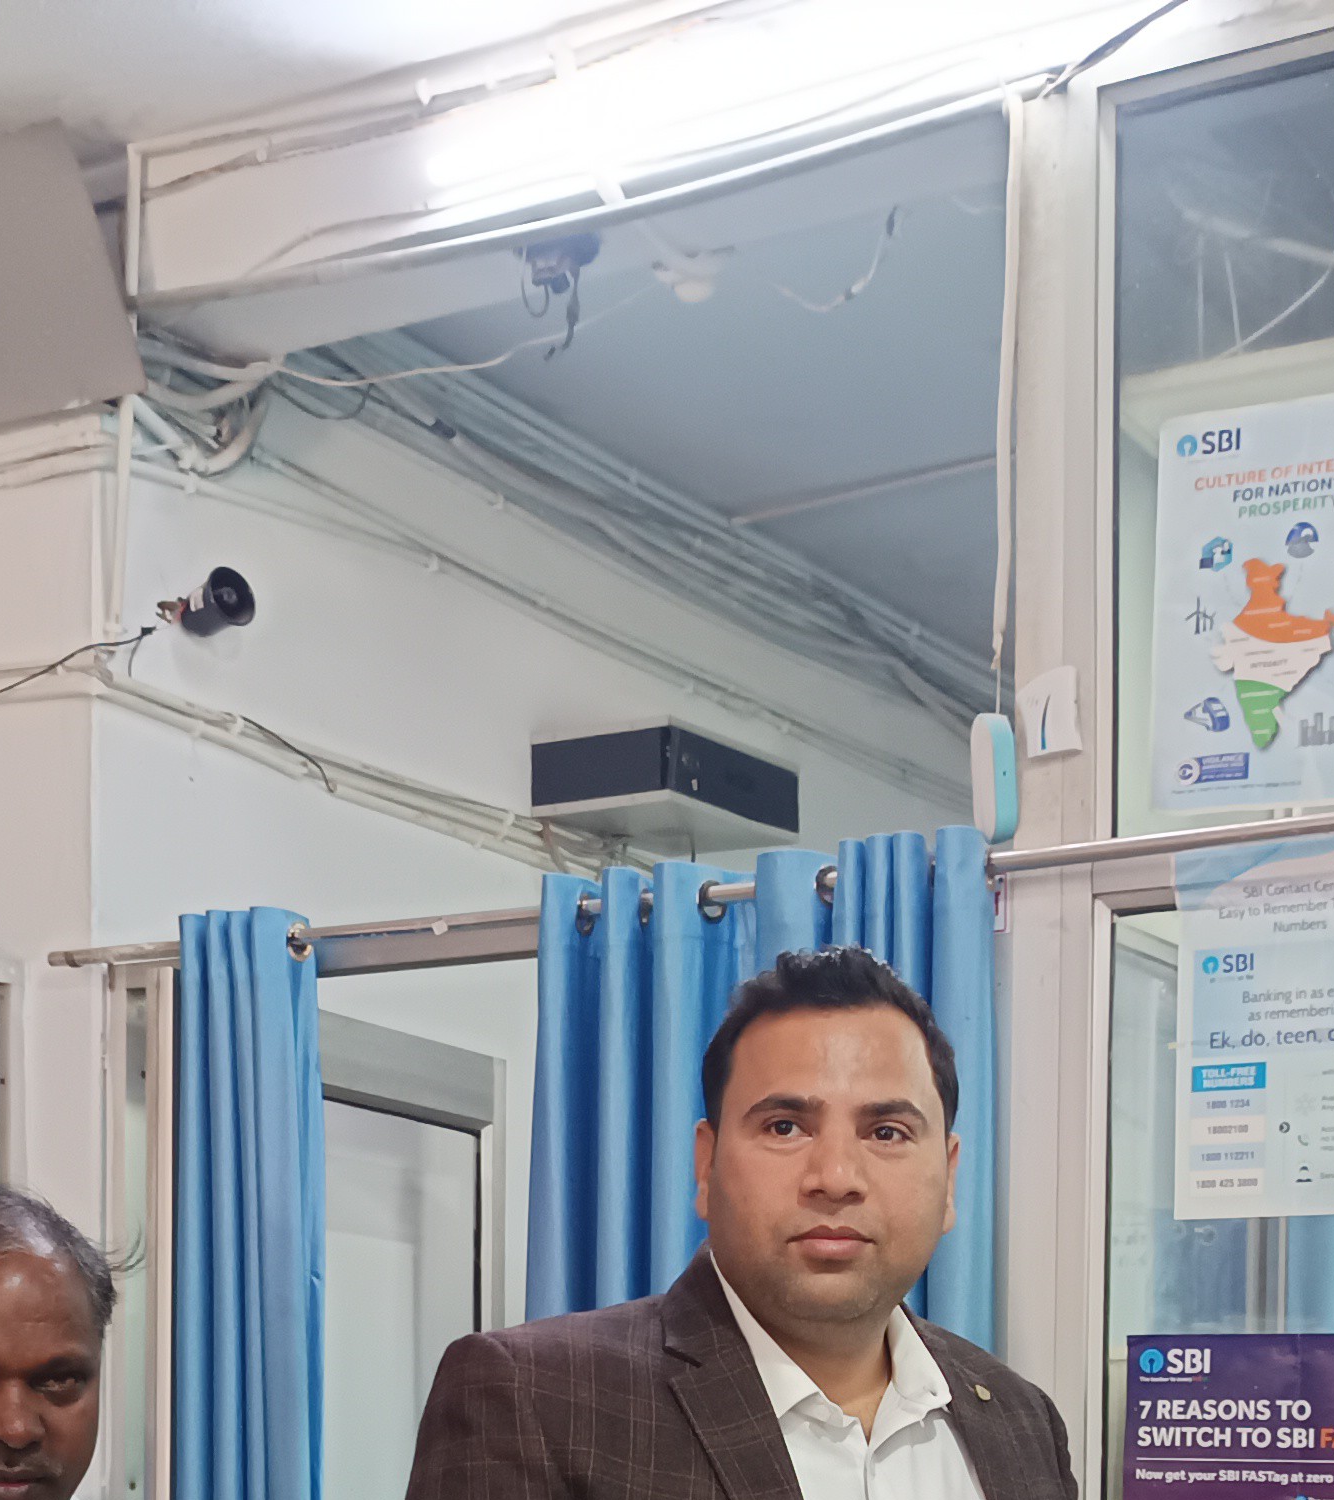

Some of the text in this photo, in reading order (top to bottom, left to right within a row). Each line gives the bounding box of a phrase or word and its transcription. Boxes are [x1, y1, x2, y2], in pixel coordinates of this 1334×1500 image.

[1201, 428, 1241, 455] SBI
[1194, 468, 1266, 491] CULTURE
[1271, 465, 1293, 480] OF
[1233, 487, 1264, 502] FOR
[1242, 884, 1266, 900] SBI
[1266, 882, 1311, 898] Contact
[1218, 906, 1246, 921] Easy
[1248, 905, 1261, 917] to
[1263, 900, 1328, 916] Remember
[1273, 919, 1327, 933] Numbers
[1222, 953, 1255, 974] SBI
[1241, 990, 1293, 1006] Banking
[1310, 988, 1325, 999] as
[1247, 1010, 1262, 1022] as
[1209, 1031, 1236, 1050] Ek,
[1201, 1066, 1257, 1079] TOLL-FREE
[1203, 1076, 1255, 1088] NUMBERS
[1230, 1099, 1251, 1109] 1234
[1166, 1348, 1211, 1374] SBI
[1139, 1399, 1312, 1421] 7 REASONS TO
[1137, 1426, 1231, 1448] SWITCH
[1236, 1427, 1272, 1449] TO
[1276, 1427, 1315, 1449] SBI
[1135, 1468, 1164, 1480] Now
[1165, 1470, 1187, 1484] get
[1187, 1473, 1218, 1484] your
[1218, 1470, 1240, 1482] SBI
[1241, 1470, 1289, 1486] FASTag
[1290, 1471, 1304, 1483] at
[1305, 1473, 1334, 1484] zero
